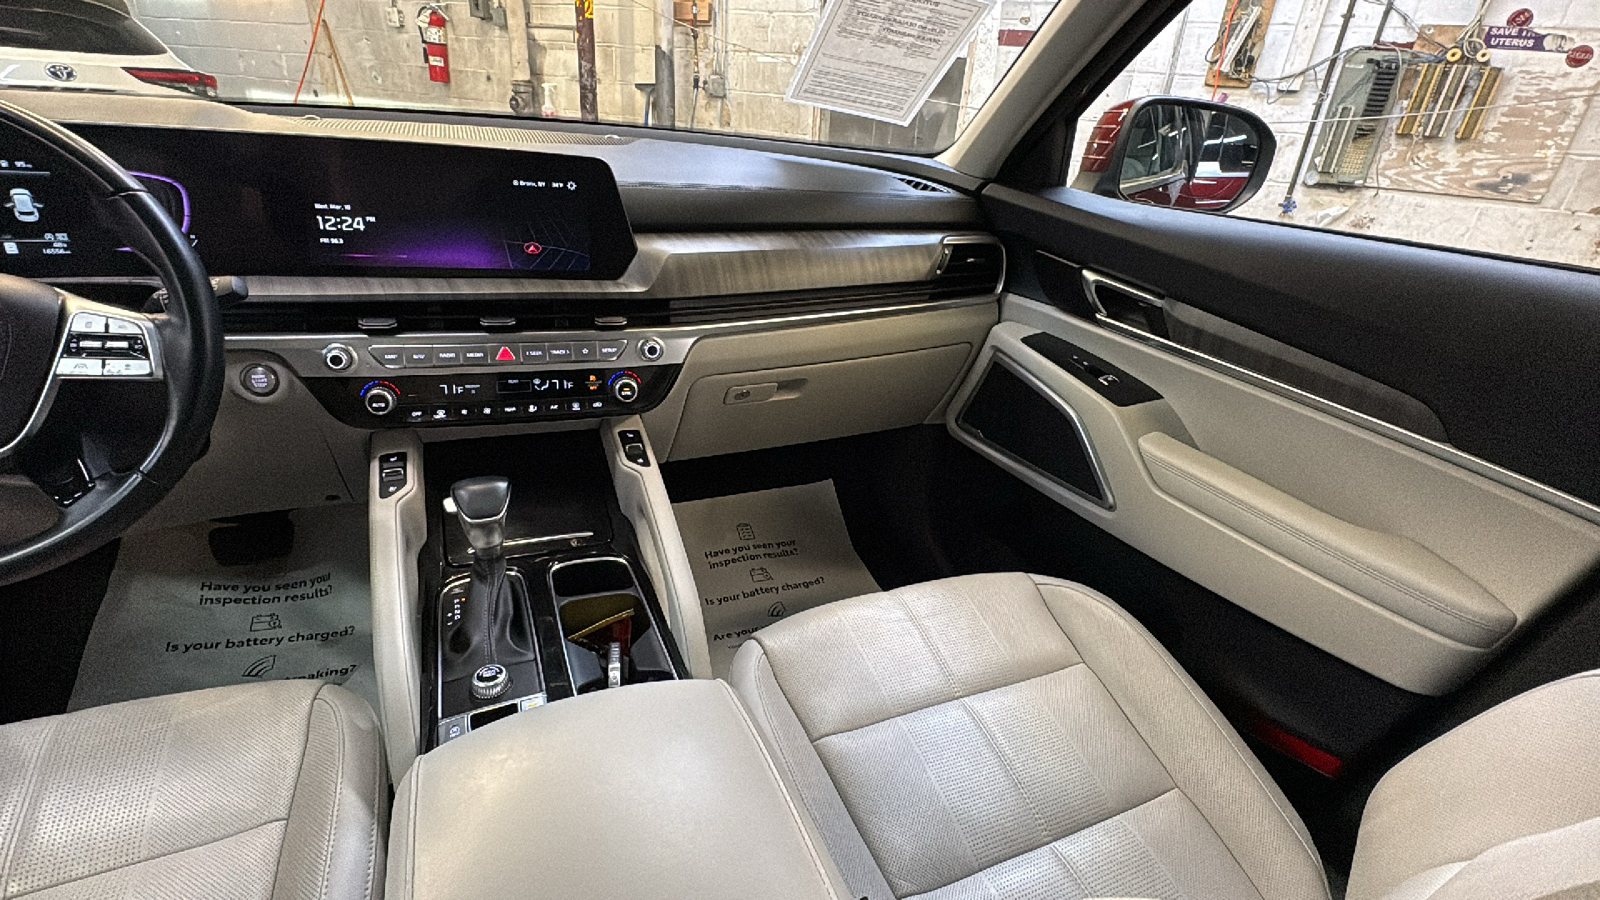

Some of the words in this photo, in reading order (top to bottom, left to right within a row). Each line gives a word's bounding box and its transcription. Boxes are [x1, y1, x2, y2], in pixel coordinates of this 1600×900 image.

[1490, 27, 1519, 36] SAVE
[1490, 37, 1535, 48] UTERUS
[316, 215, 366, 231] 12:24
[704, 548, 730, 560] Have
[732, 544, 750, 554] you
[775, 540, 796, 549] your
[708, 554, 762, 570] inspection
[763, 548, 799, 558] results?
[199, 594, 281, 607] inspection
[284, 584, 333, 602] results?
[200, 581, 240, 592] Have
[242, 583, 271, 594] you
[274, 580, 308, 592] seen
[704, 598, 716, 606] Is
[716, 594, 741, 606] your
[742, 585, 779, 599] battery
[782, 576, 826, 591] charged?
[164, 642, 179, 652] Is
[181, 640, 222, 654] your
[224, 634, 284, 650] battery
[287, 625, 356, 643] charged?
[713, 632, 733, 642] Are
